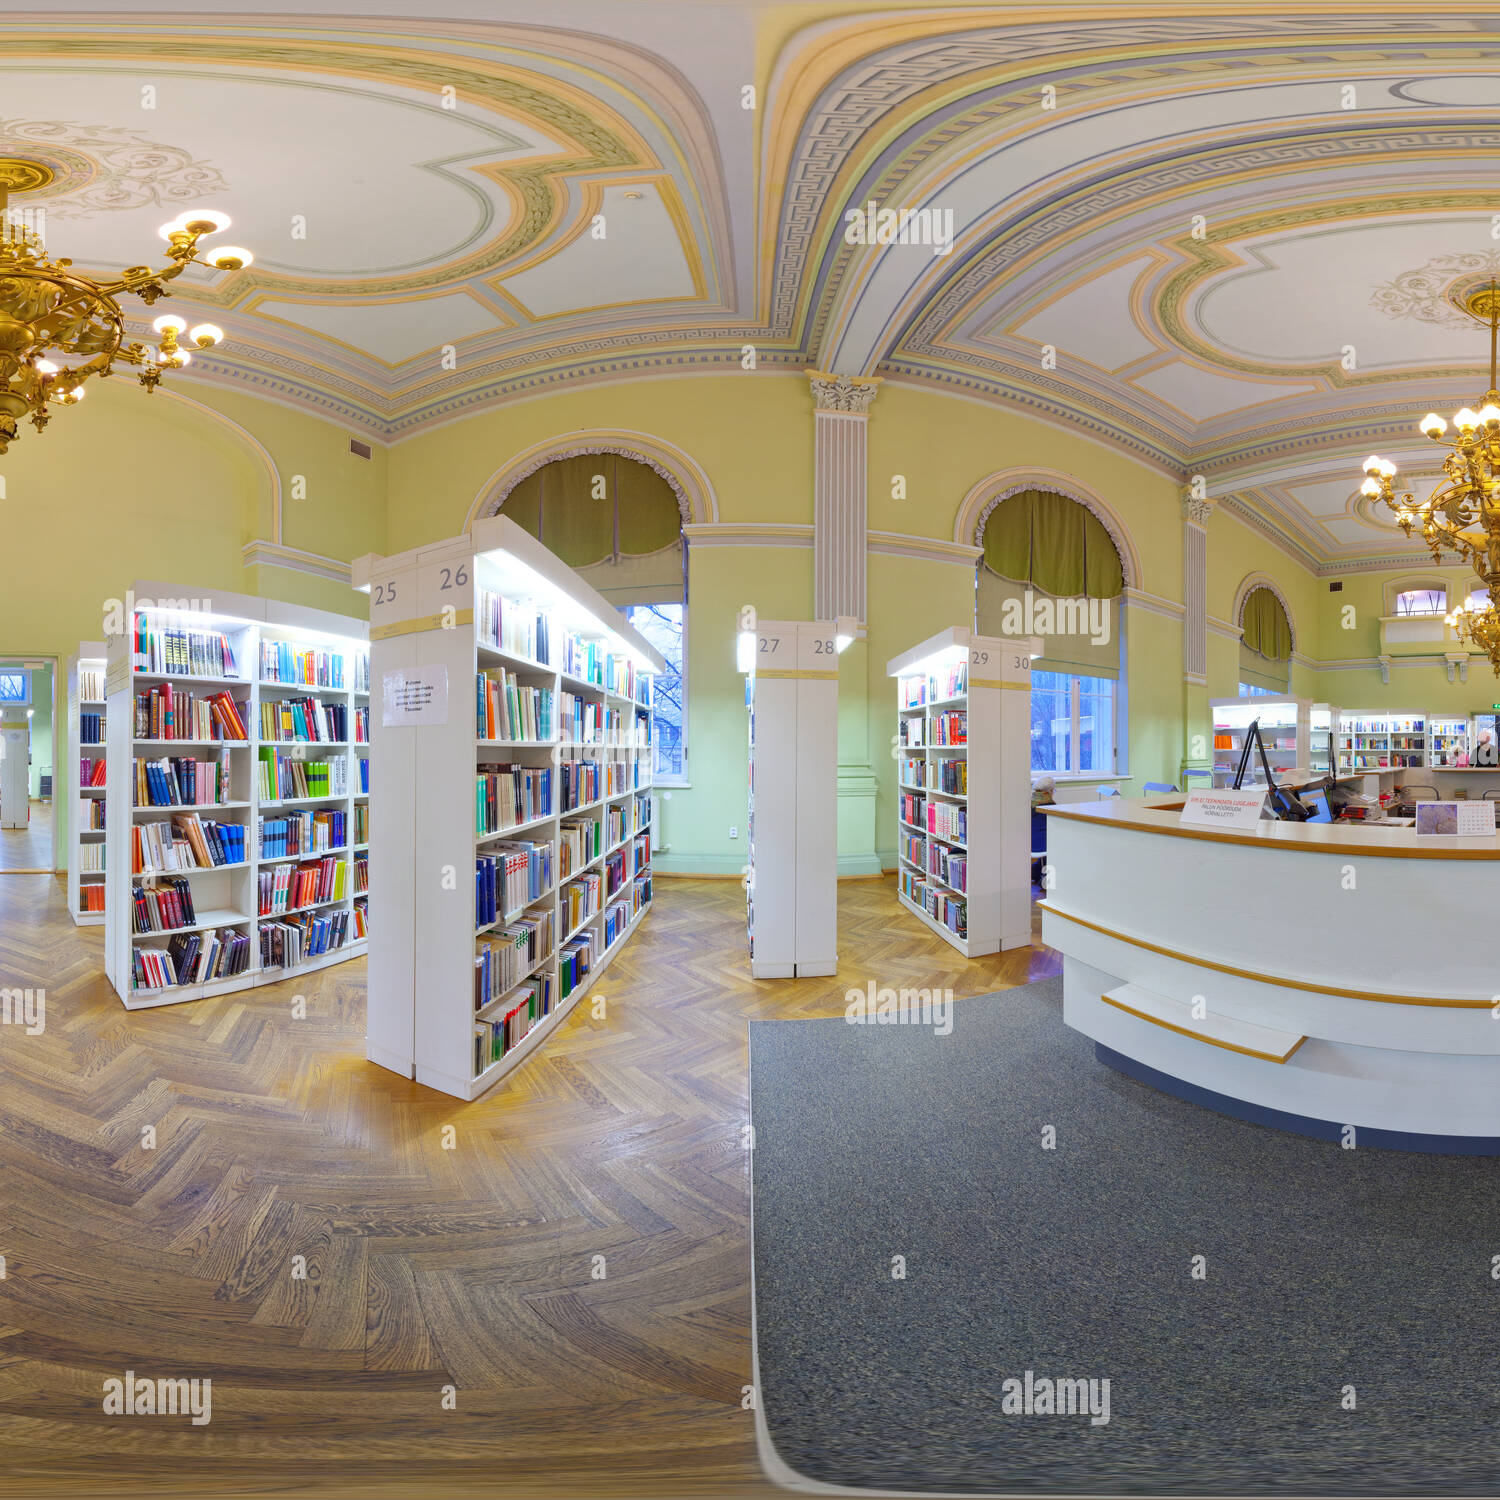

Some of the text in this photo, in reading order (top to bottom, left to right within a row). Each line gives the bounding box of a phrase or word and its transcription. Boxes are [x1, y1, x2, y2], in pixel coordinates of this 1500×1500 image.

[440, 563, 469, 590] 26
[374, 580, 397, 606] 25
[759, 638, 780, 653] 27
[814, 639, 835, 655] 28
[972, 652, 988, 665] 29
[1013, 656, 1029, 670] 30
